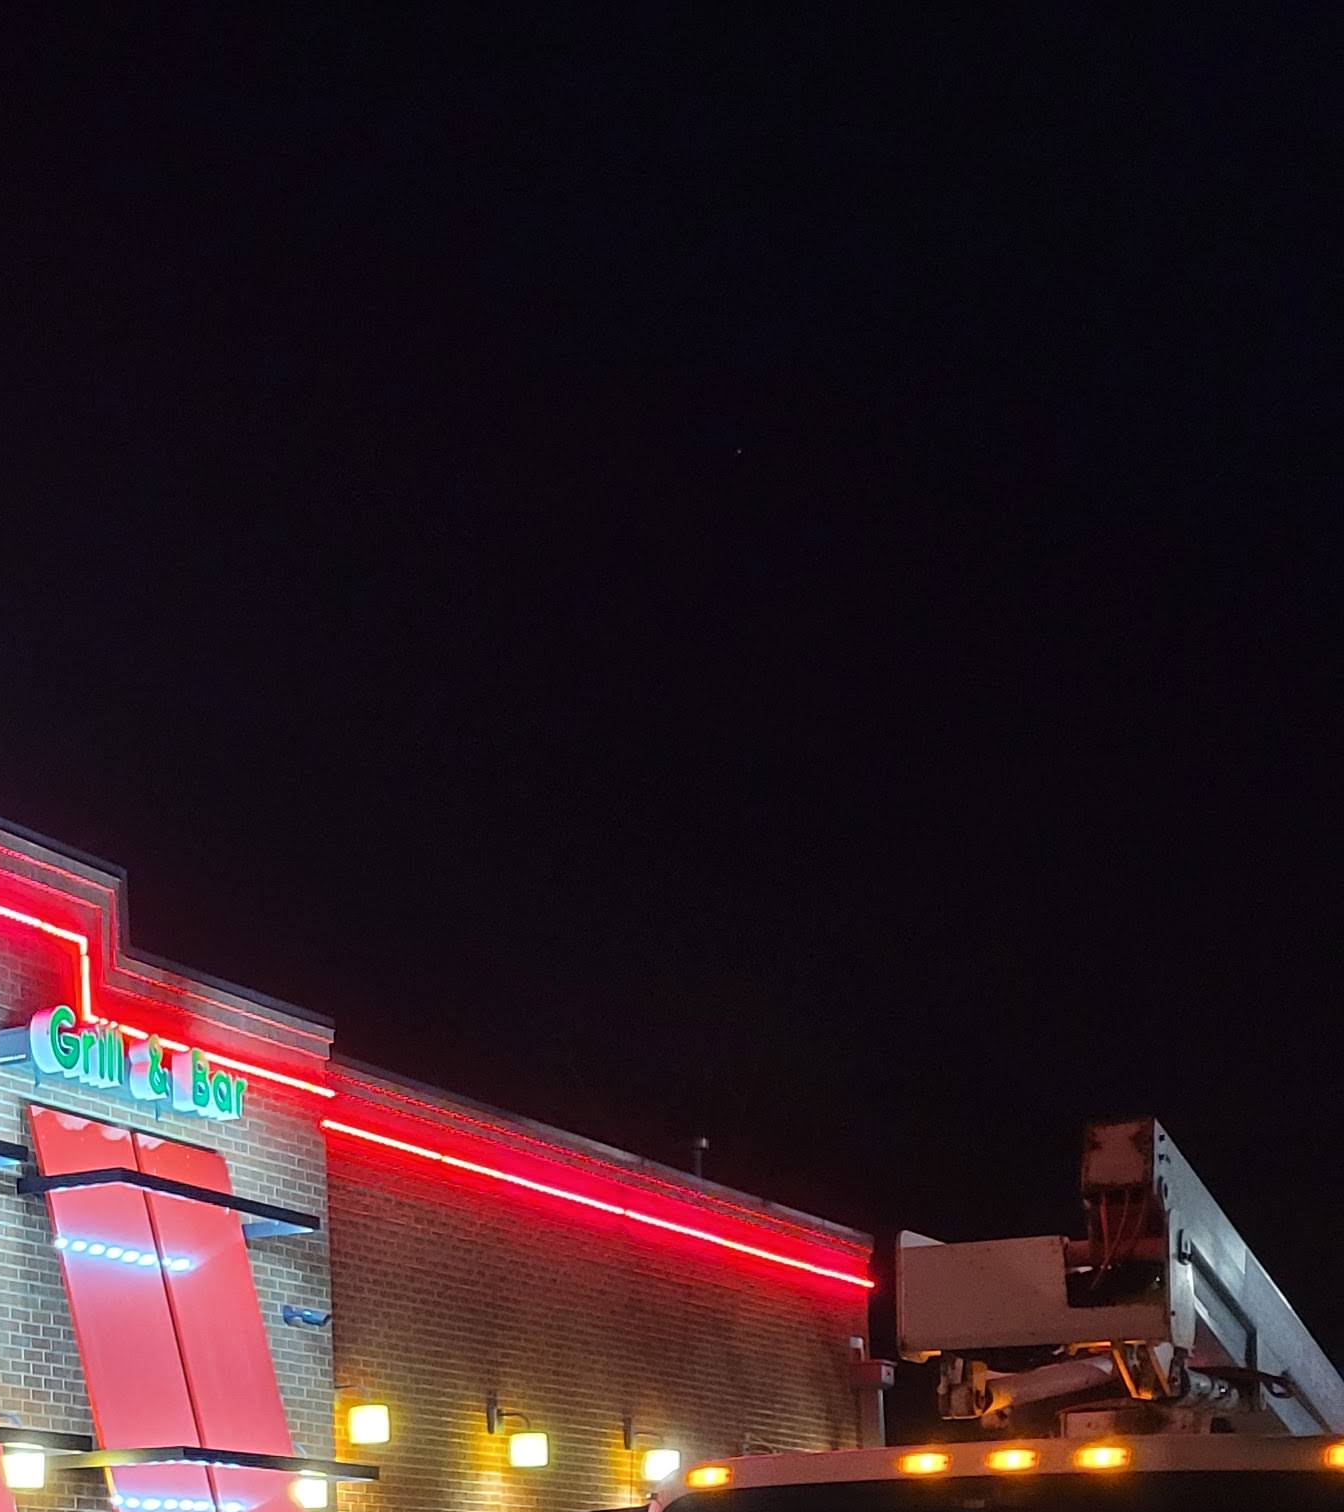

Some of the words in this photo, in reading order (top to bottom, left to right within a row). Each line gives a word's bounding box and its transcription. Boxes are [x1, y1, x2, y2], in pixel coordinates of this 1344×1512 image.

[49, 1004, 124, 1087] Grill
[148, 1034, 170, 1097] &
[191, 1047, 247, 1119] Bar
